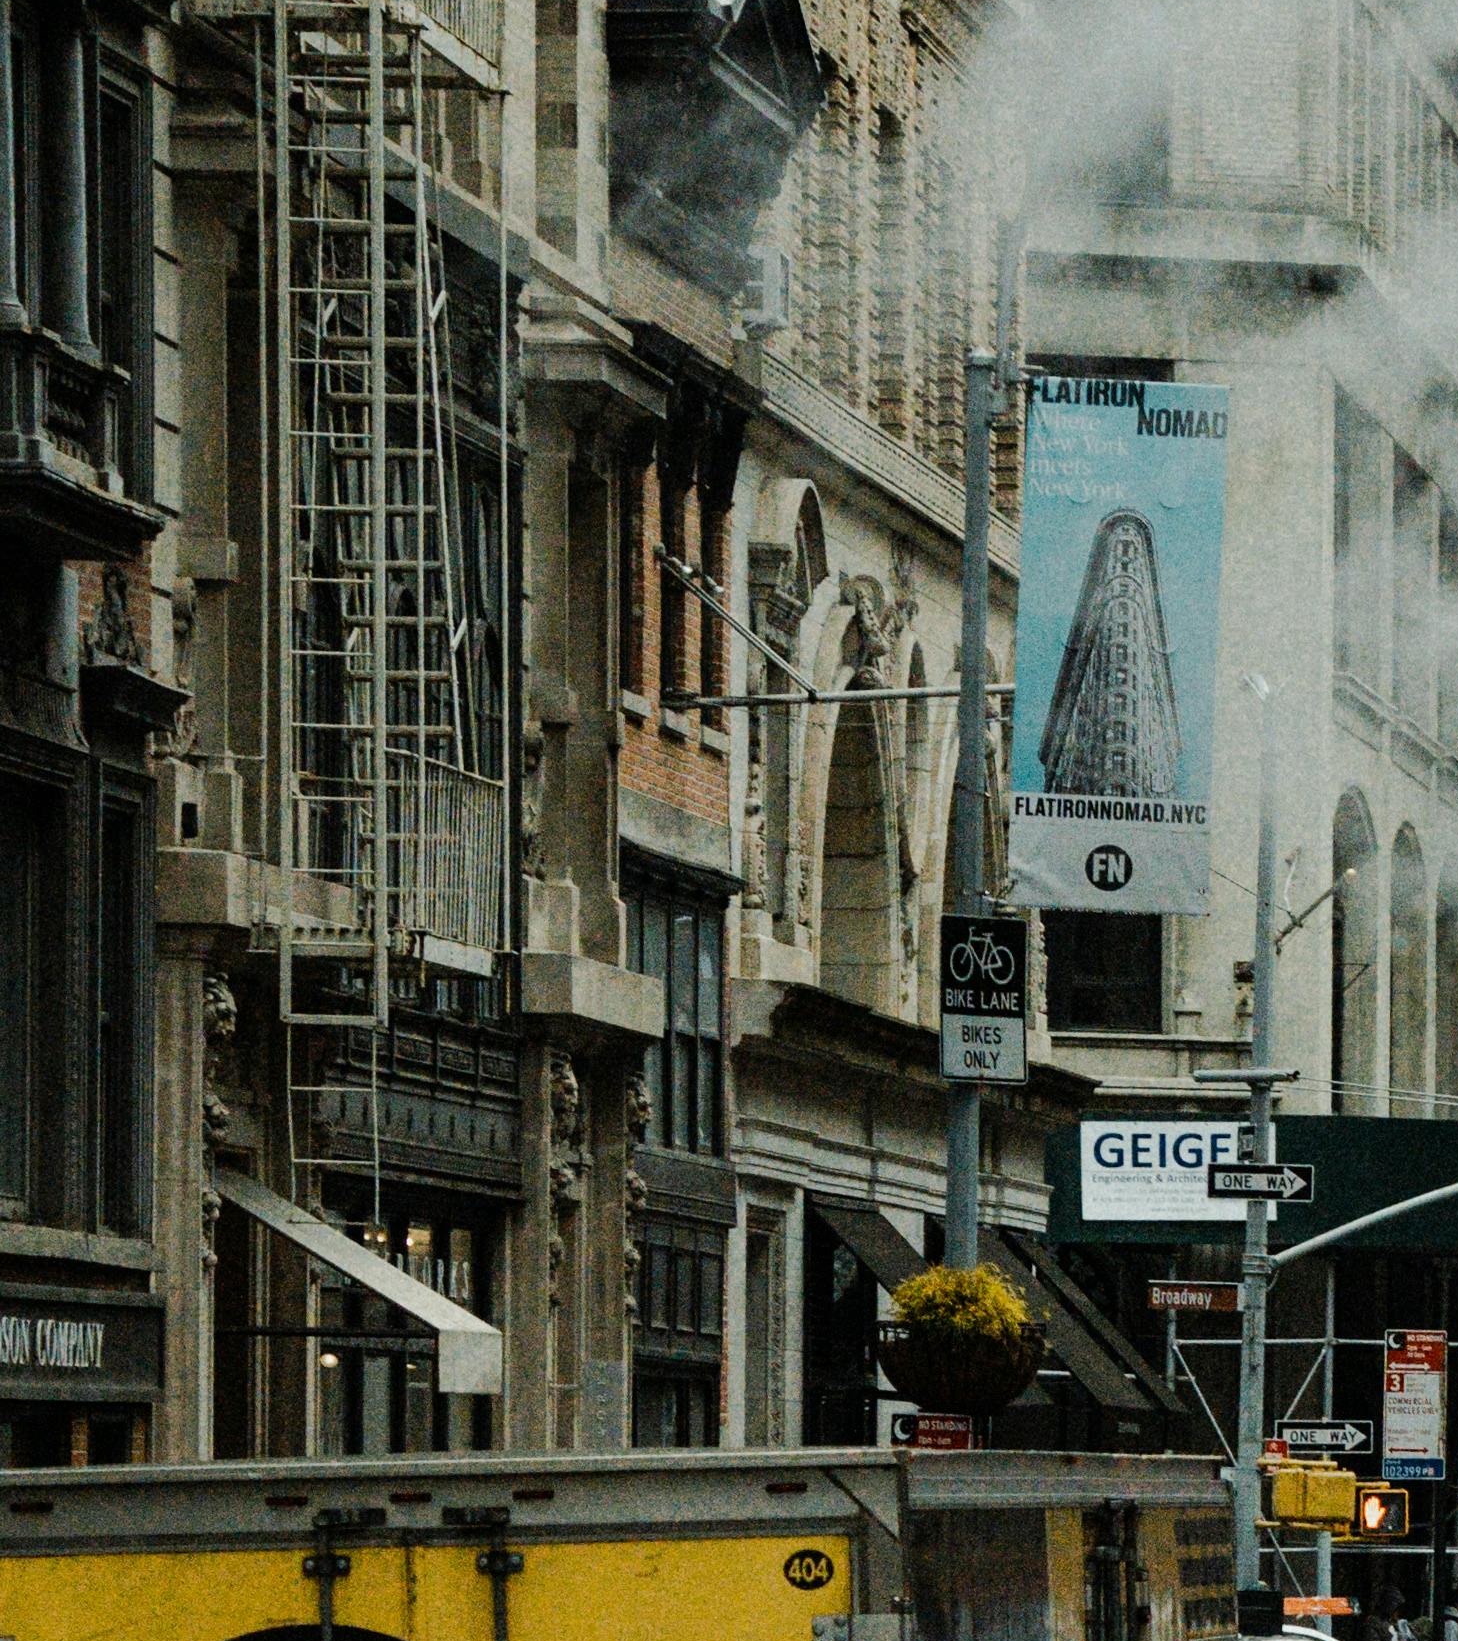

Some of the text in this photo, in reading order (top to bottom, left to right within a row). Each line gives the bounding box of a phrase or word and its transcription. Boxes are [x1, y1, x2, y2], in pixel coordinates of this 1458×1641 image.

[1028, 376, 1145, 408] FLATIRON
[1137, 408, 1229, 439] NOMAD
[1030, 435, 1130, 456] New York
[1029, 479, 1126, 500] New York
[1015, 796, 1207, 825] FLATIRONNOMAD.NYC
[1091, 853, 1126, 884] FN
[945, 988, 1020, 1011] BIKE LANE
[962, 1025, 1002, 1045] BIKES
[964, 1050, 1001, 1070] ONLY
[1093, 1133, 1232, 1168] GEIGE
[1091, 1173, 1208, 1186] Engineering & Architec
[1222, 1175, 1297, 1190] ONE WAY
[1152, 1287, 1213, 1310] Broadway
[36, 1318, 105, 1368] COMPANY
[1390, 1374, 1401, 1392] 3
[1290, 1431, 1358, 1442] ONE WAY
[788, 1557, 829, 1584] 404
